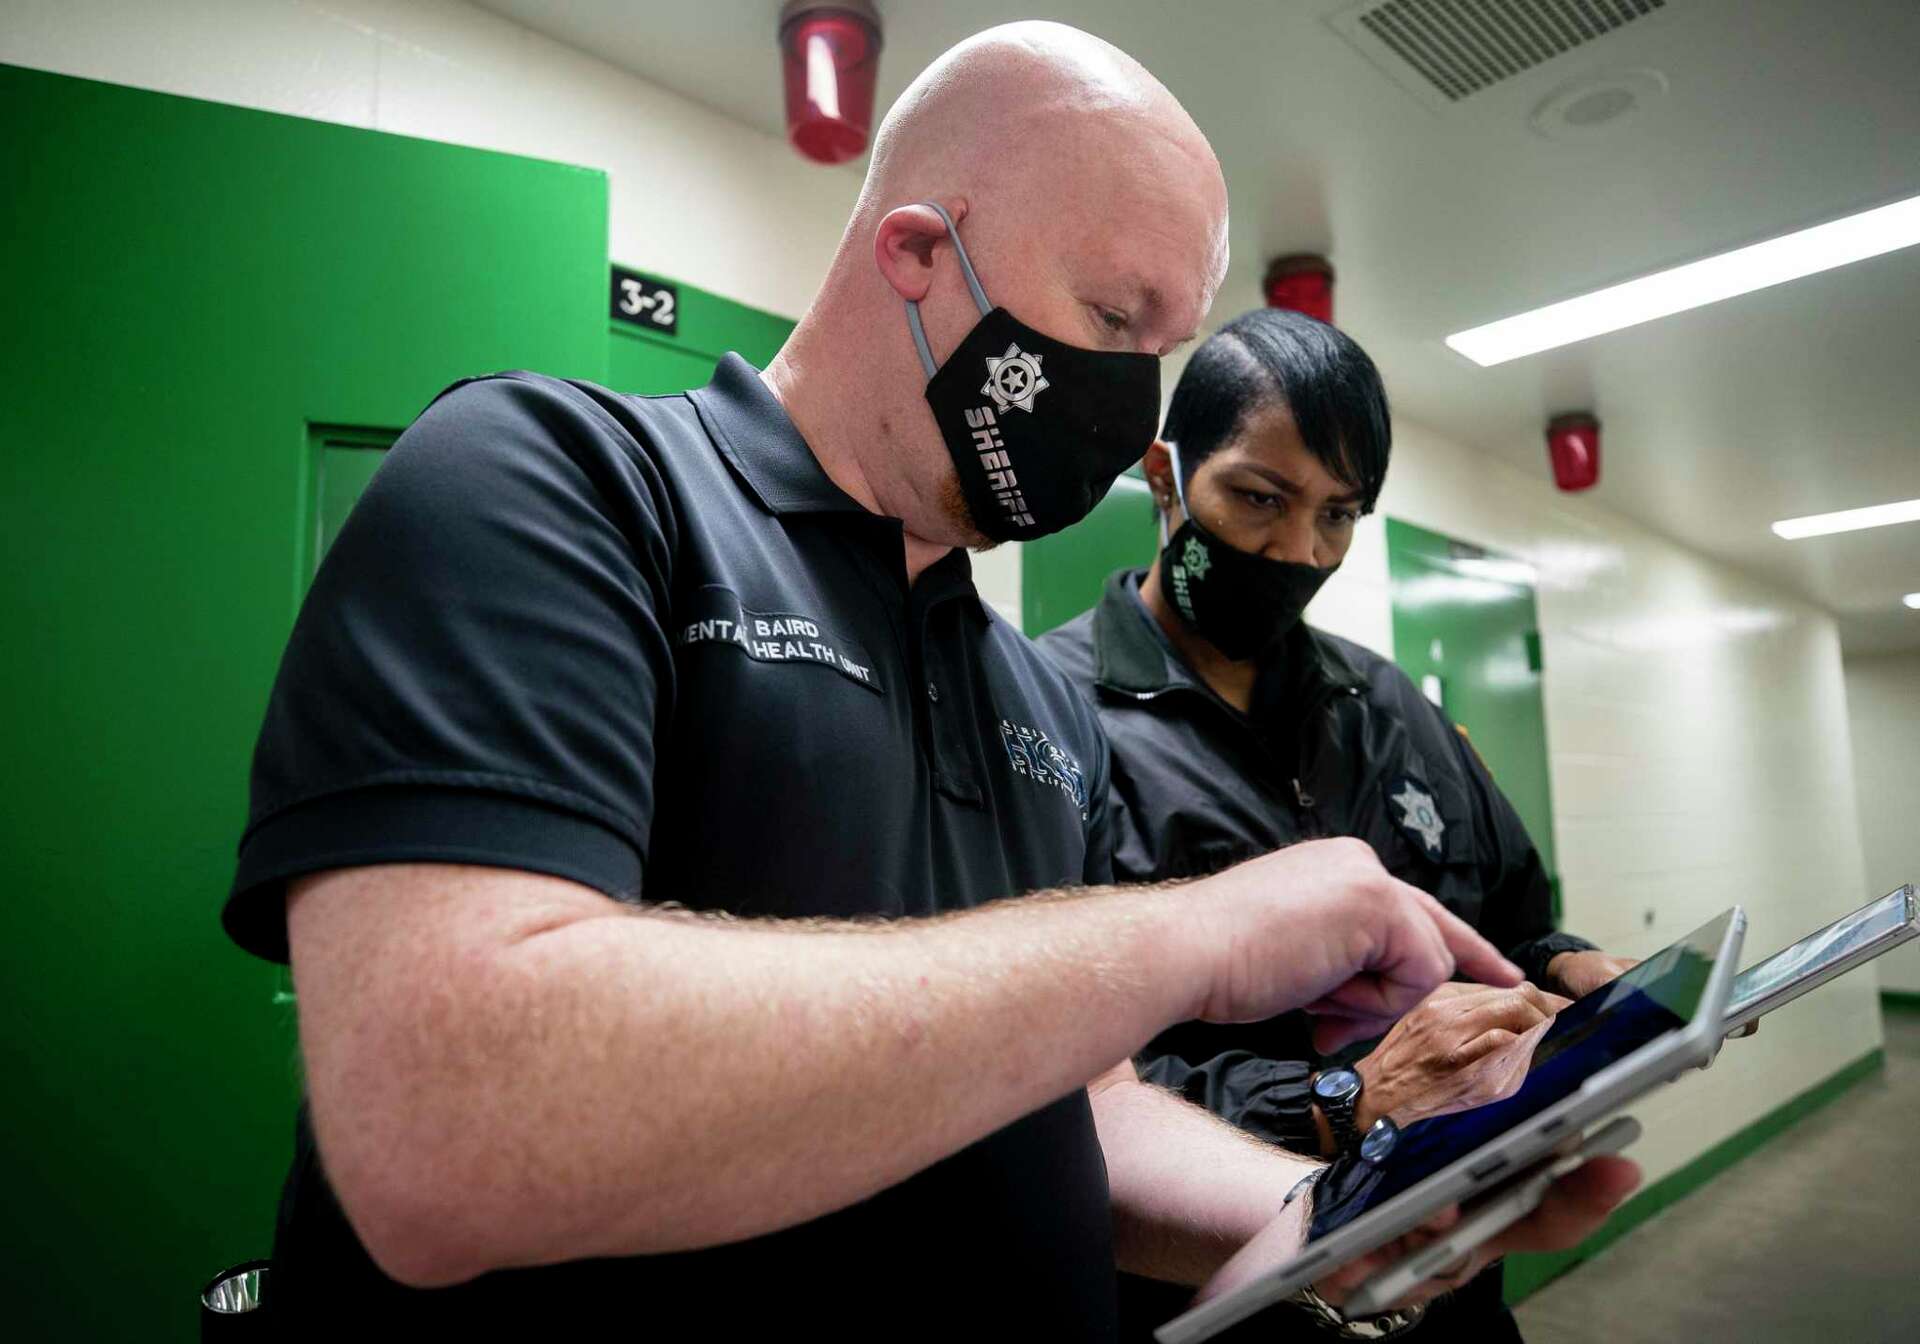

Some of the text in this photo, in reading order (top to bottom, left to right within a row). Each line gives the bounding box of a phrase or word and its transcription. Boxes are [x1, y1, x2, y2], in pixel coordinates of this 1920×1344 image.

[619, 278, 675, 326] 3-2
[963, 405, 1036, 527] SHERIFF
[681, 619, 870, 682] ENTA HEALTH UNIT
[754, 619, 820, 639] BAIRD
